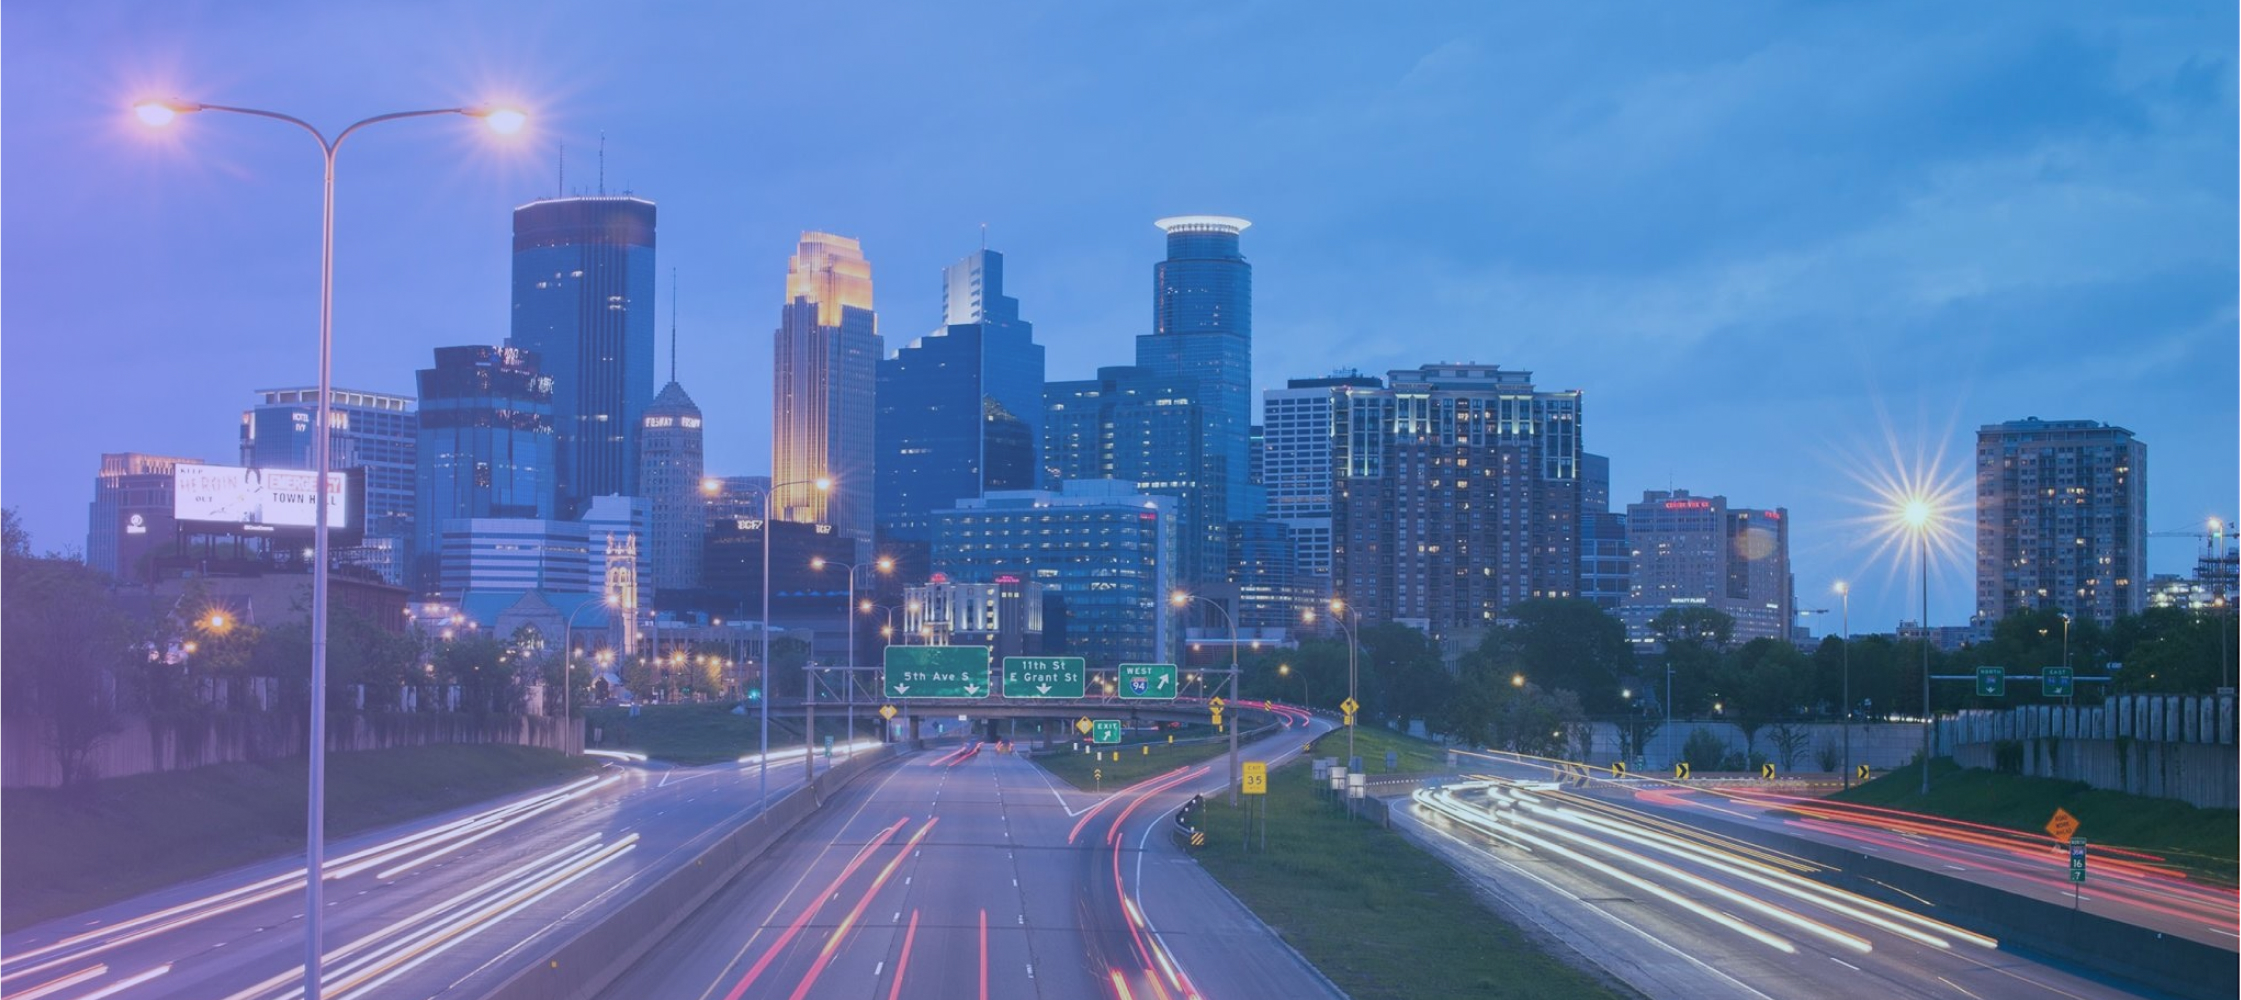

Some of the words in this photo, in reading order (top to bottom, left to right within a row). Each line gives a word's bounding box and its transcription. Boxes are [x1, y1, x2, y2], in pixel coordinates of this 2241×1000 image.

[195, 495, 213, 503] OUT
[273, 493, 304, 504] TOWN
[309, 494, 336, 506] HL
[1022, 661, 1046, 670] 11th
[1052, 661, 1065, 670] St
[904, 671, 926, 681] 5th
[933, 671, 955, 681] Ave
[961, 671, 969, 681] S
[1126, 667, 1152, 675] WEST
[1010, 672, 1017, 682] E
[1024, 672, 1058, 682] Grant
[1064, 672, 1078, 682] St
[1132, 682, 1145, 691] 94
[1247, 775, 1263, 785] 35
[2073, 858, 2083, 868] 16
